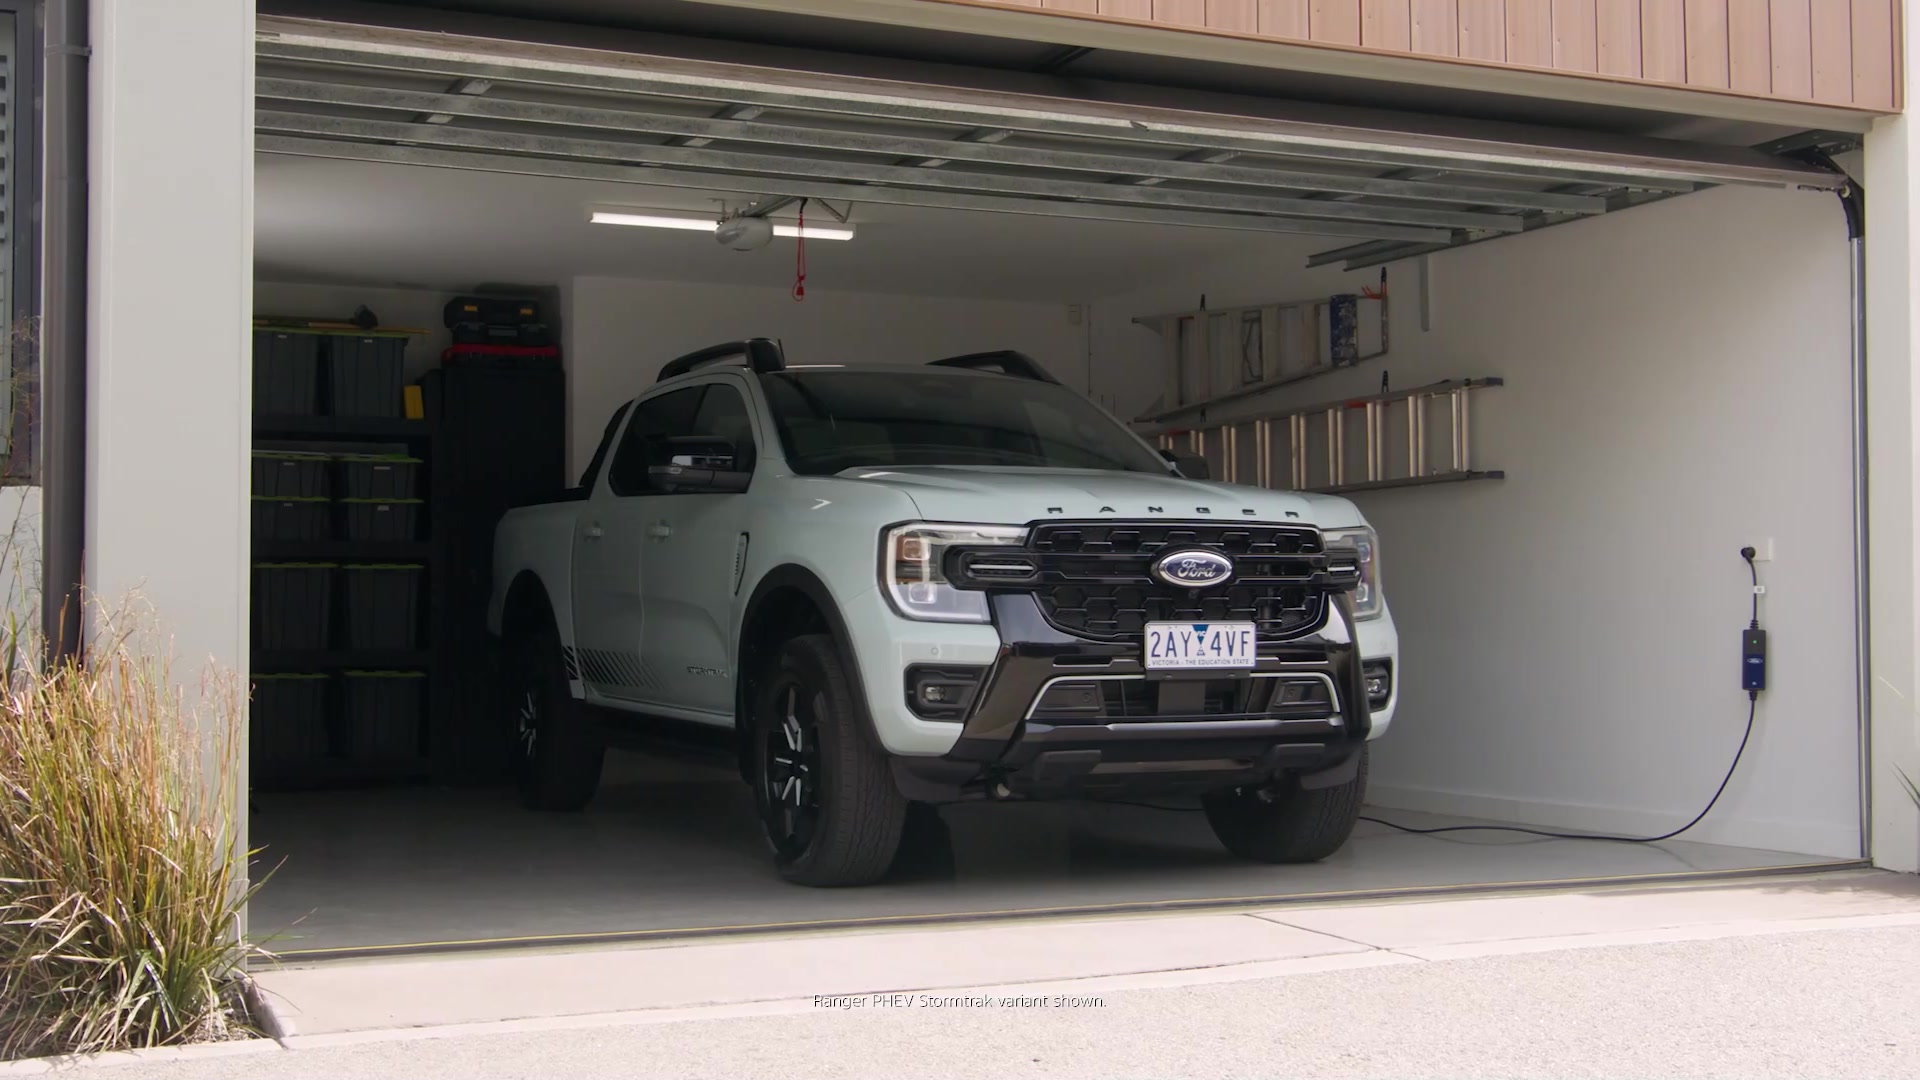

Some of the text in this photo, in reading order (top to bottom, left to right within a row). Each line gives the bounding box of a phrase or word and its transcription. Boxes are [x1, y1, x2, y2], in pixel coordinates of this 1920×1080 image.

[1047, 506, 1299, 518] RANGER
[1178, 558, 1216, 578] Ford
[1150, 631, 1251, 657] 2AY 4VF
